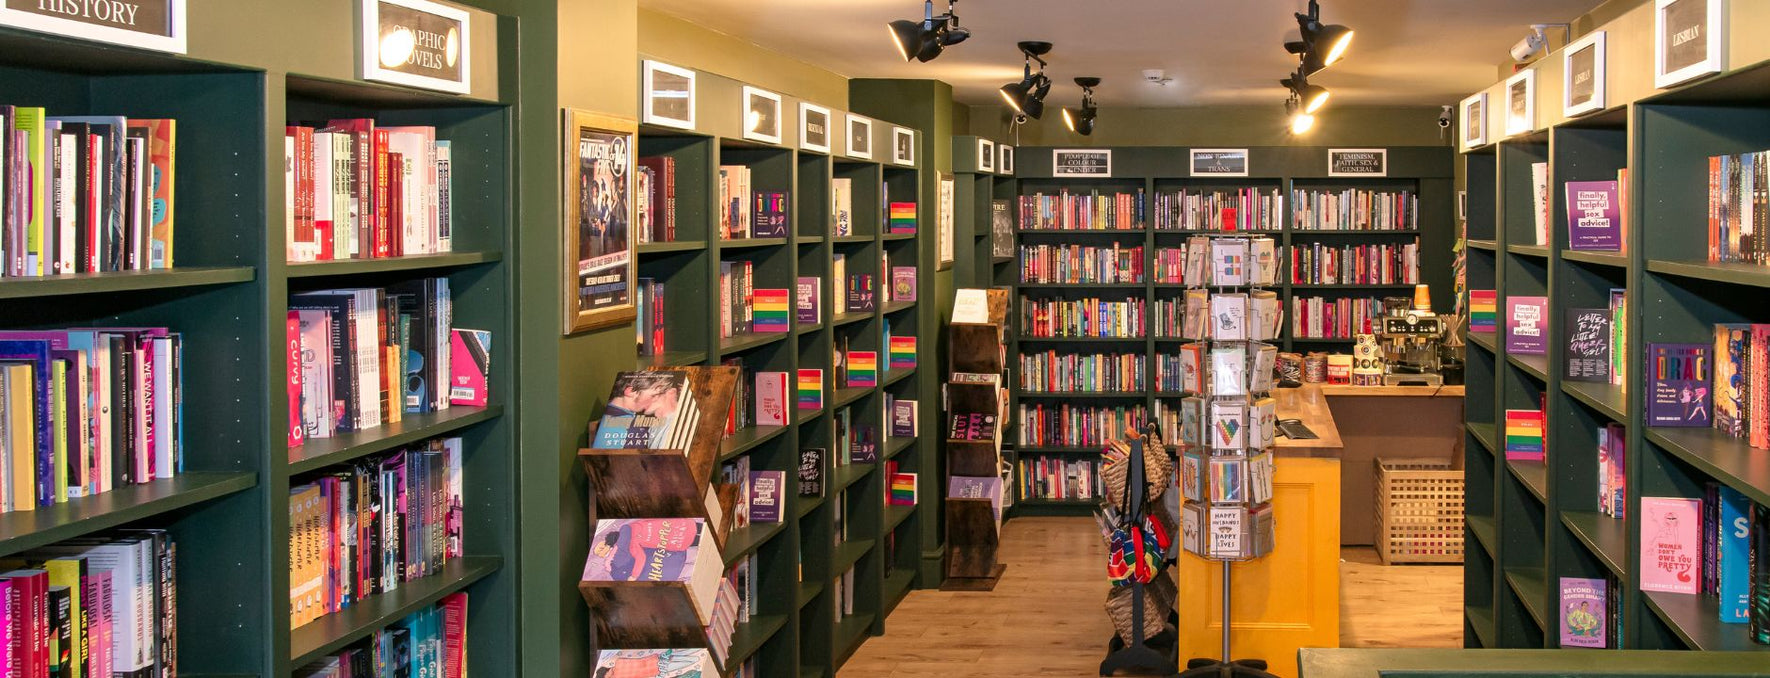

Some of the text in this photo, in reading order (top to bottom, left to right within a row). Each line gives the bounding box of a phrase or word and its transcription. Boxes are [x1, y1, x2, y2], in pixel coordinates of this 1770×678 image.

[1580, 201, 1607, 210] helpful
[1580, 219, 1609, 227] advice!
[1577, 313, 1608, 325] LETTER
[1578, 321, 1601, 336] TO MY
[1570, 331, 1597, 343] LITTLE
[1570, 339, 1607, 354] QUEER
[144, 361, 152, 379] WE
[1656, 356, 1706, 380] DRAG
[144, 380, 152, 412] WANT
[144, 413, 152, 424] IT
[956, 415, 967, 439] SLUT
[648, 520, 672, 581] HEARTSTOPPER
[1678, 554, 1692, 563] YOU
[1658, 561, 1692, 573] PRETTY
[88, 582, 98, 629] FABULOSA!
[103, 578, 112, 624] FABULOSA!
[5, 586, 13, 668] Before We Were
[81, 637, 89, 664] GIRL
